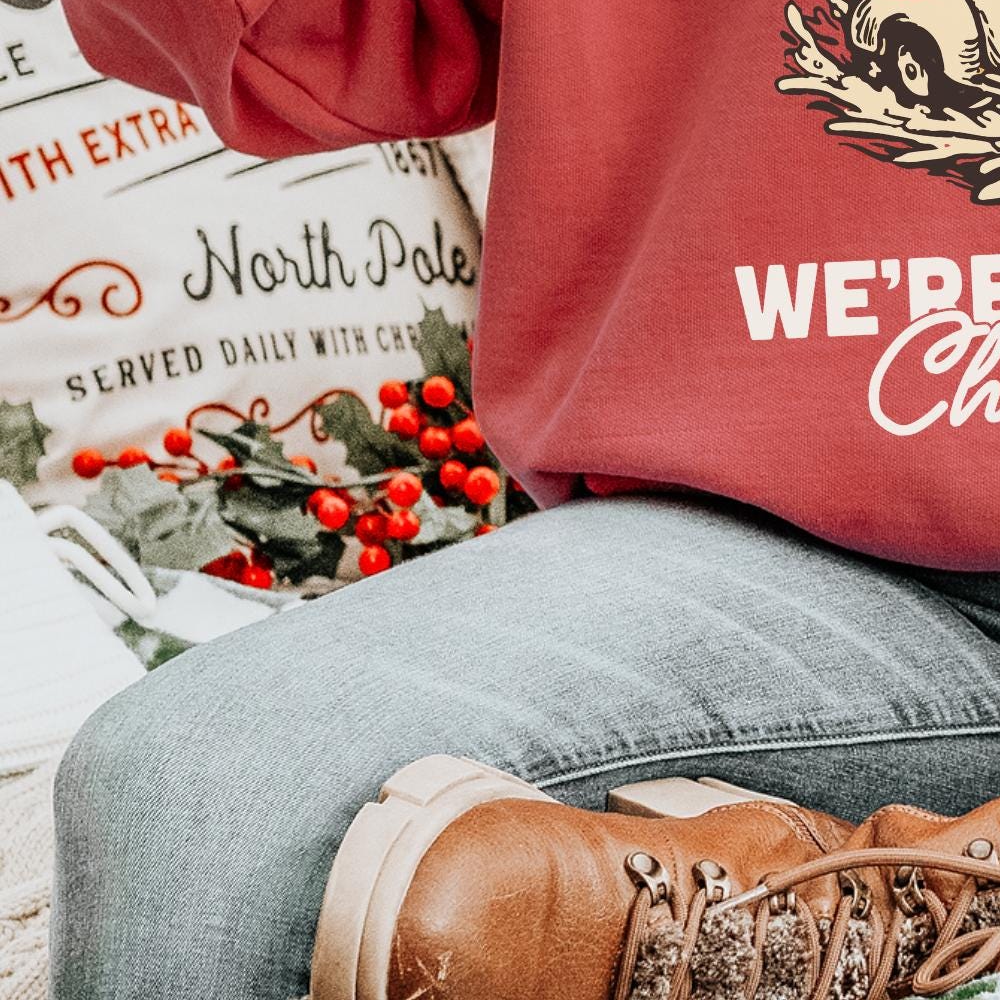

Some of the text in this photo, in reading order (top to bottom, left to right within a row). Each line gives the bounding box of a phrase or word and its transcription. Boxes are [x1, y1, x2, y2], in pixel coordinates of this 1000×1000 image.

[79, 101, 199, 167] EXTRA
[183, 219, 476, 301] North Pole
[65, 345, 203, 401] SERVED
[219, 329, 297, 366] DAILY
[309, 325, 368, 357] WITH
